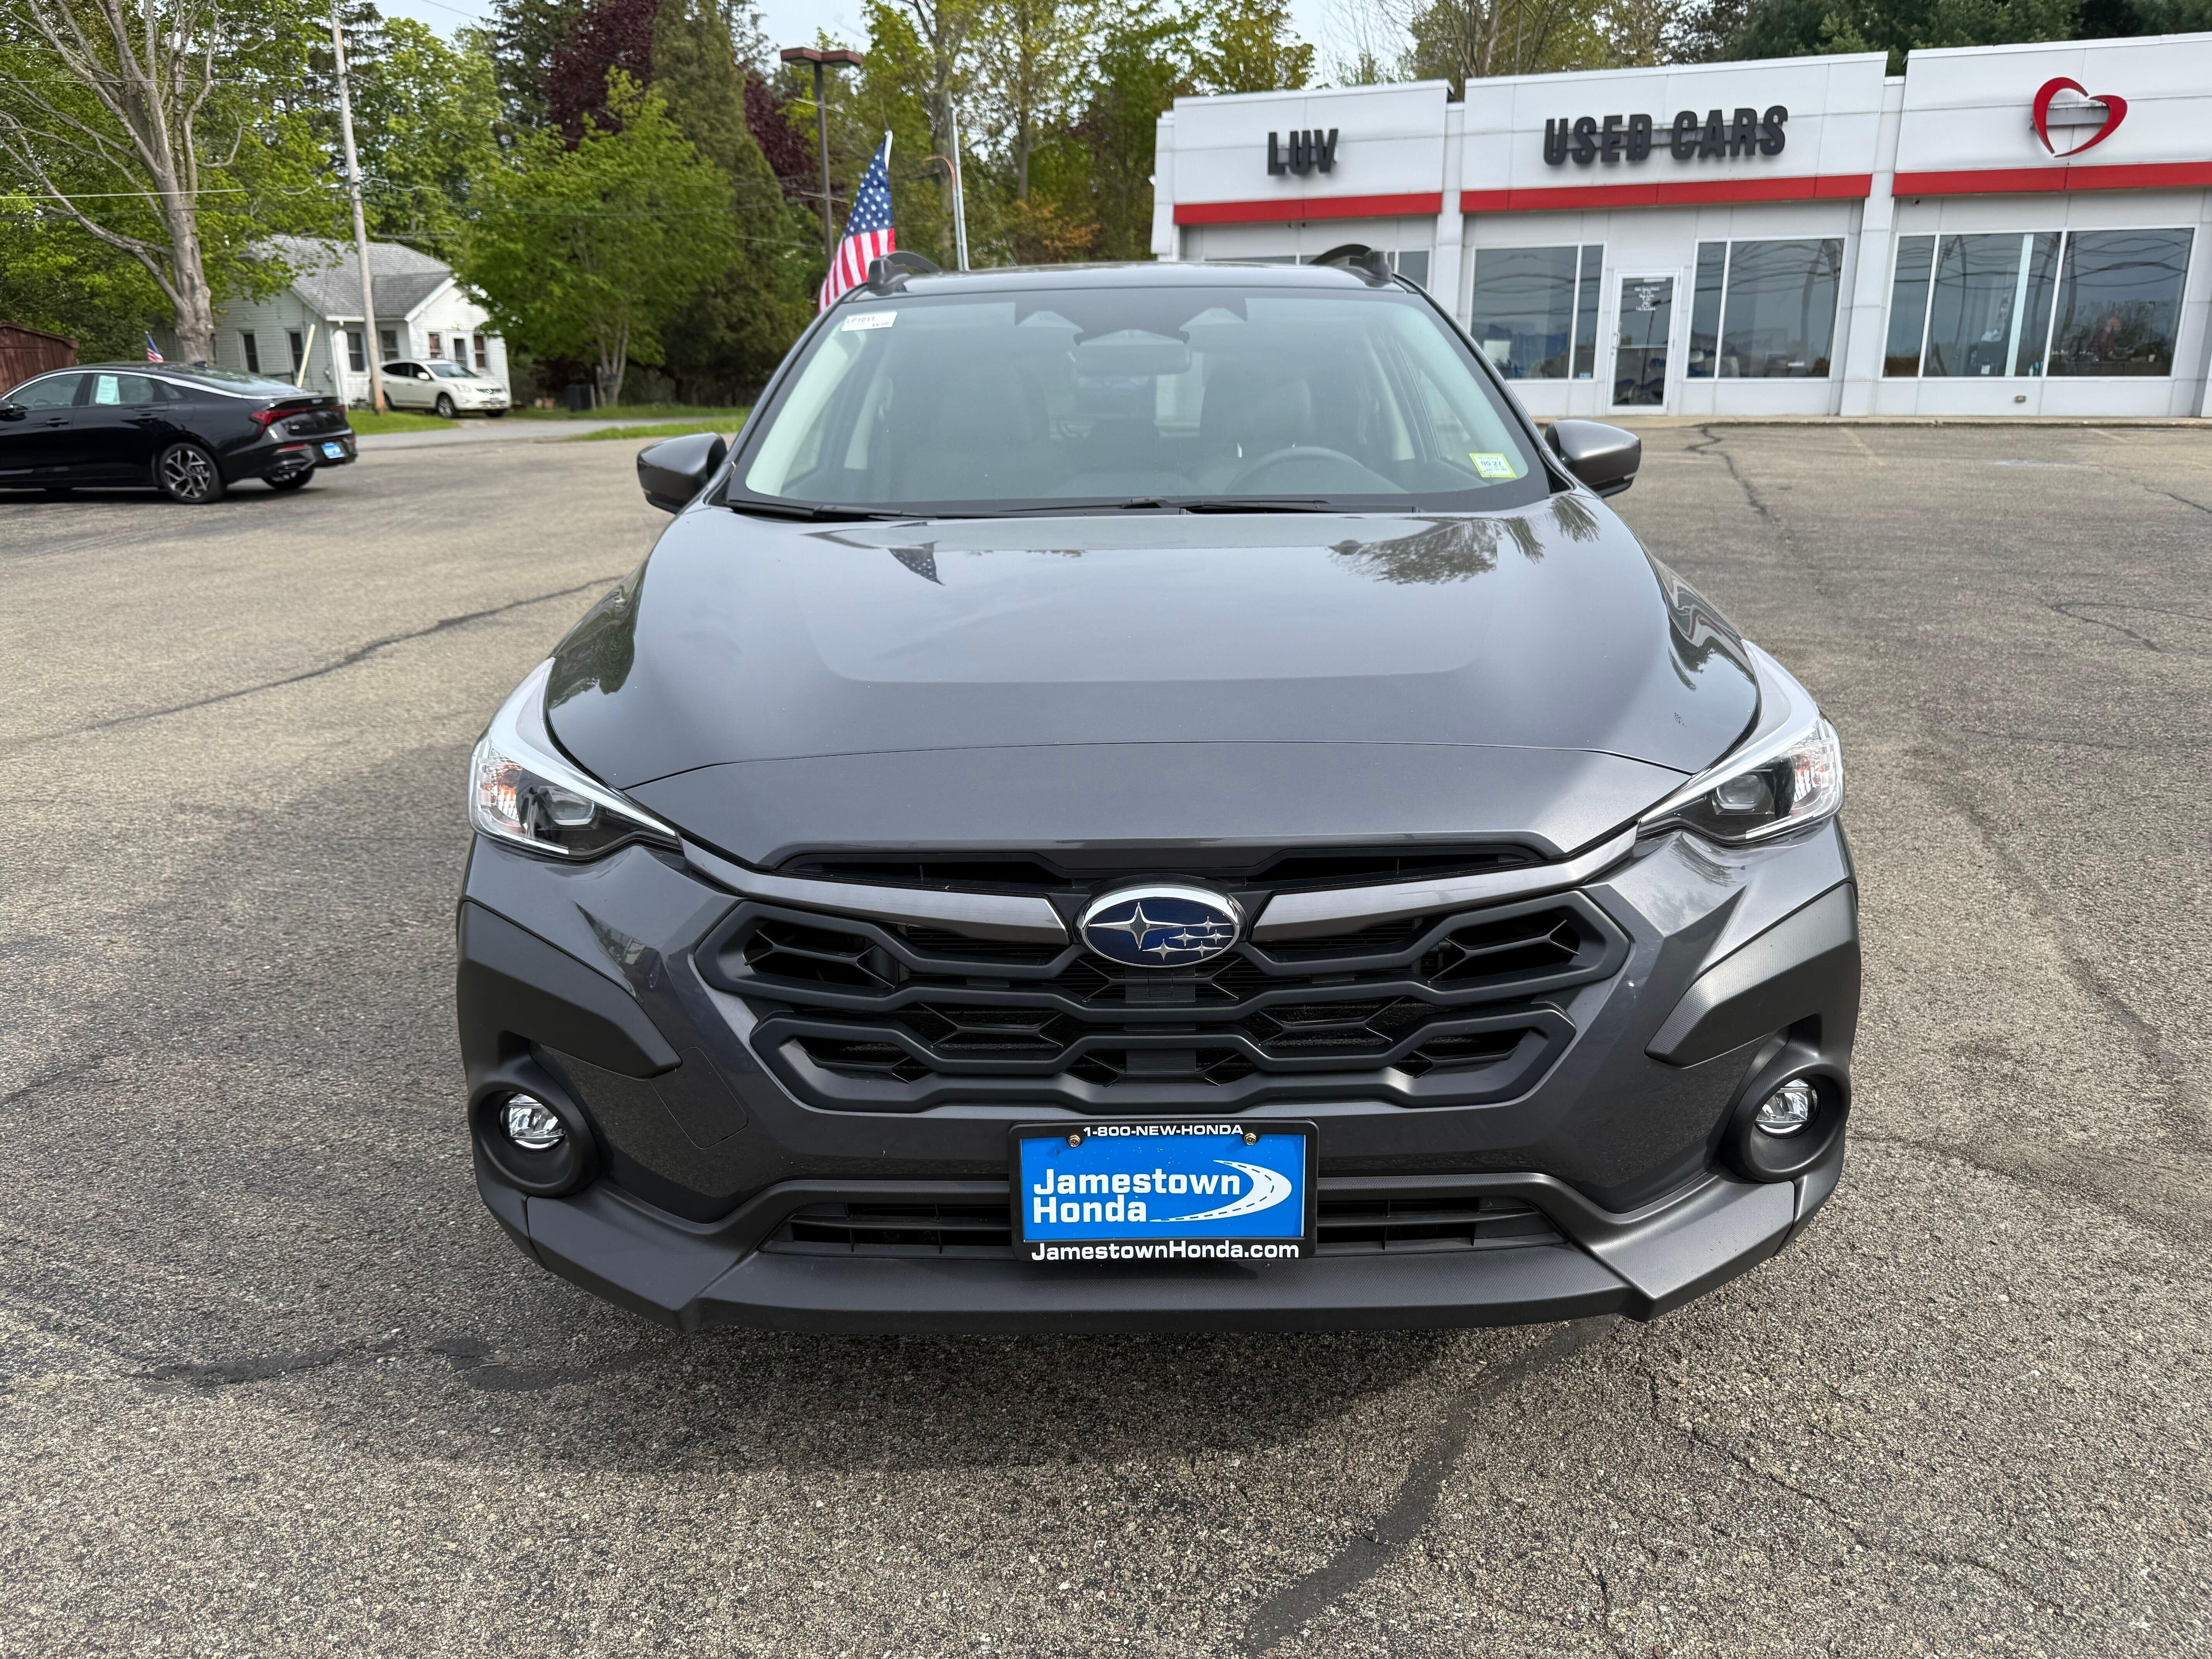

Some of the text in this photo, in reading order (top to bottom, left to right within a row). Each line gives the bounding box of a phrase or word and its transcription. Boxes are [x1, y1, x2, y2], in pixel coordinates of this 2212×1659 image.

[1268, 105, 1788, 175] LUV USED CARS
[1083, 1125, 1243, 1137] 1-800-NEW-HONDA
[1033, 1168, 1240, 1195] Jamestown
[1033, 1194, 1147, 1223] Honda
[1031, 1240, 1299, 1261] JamestownHonda.com
